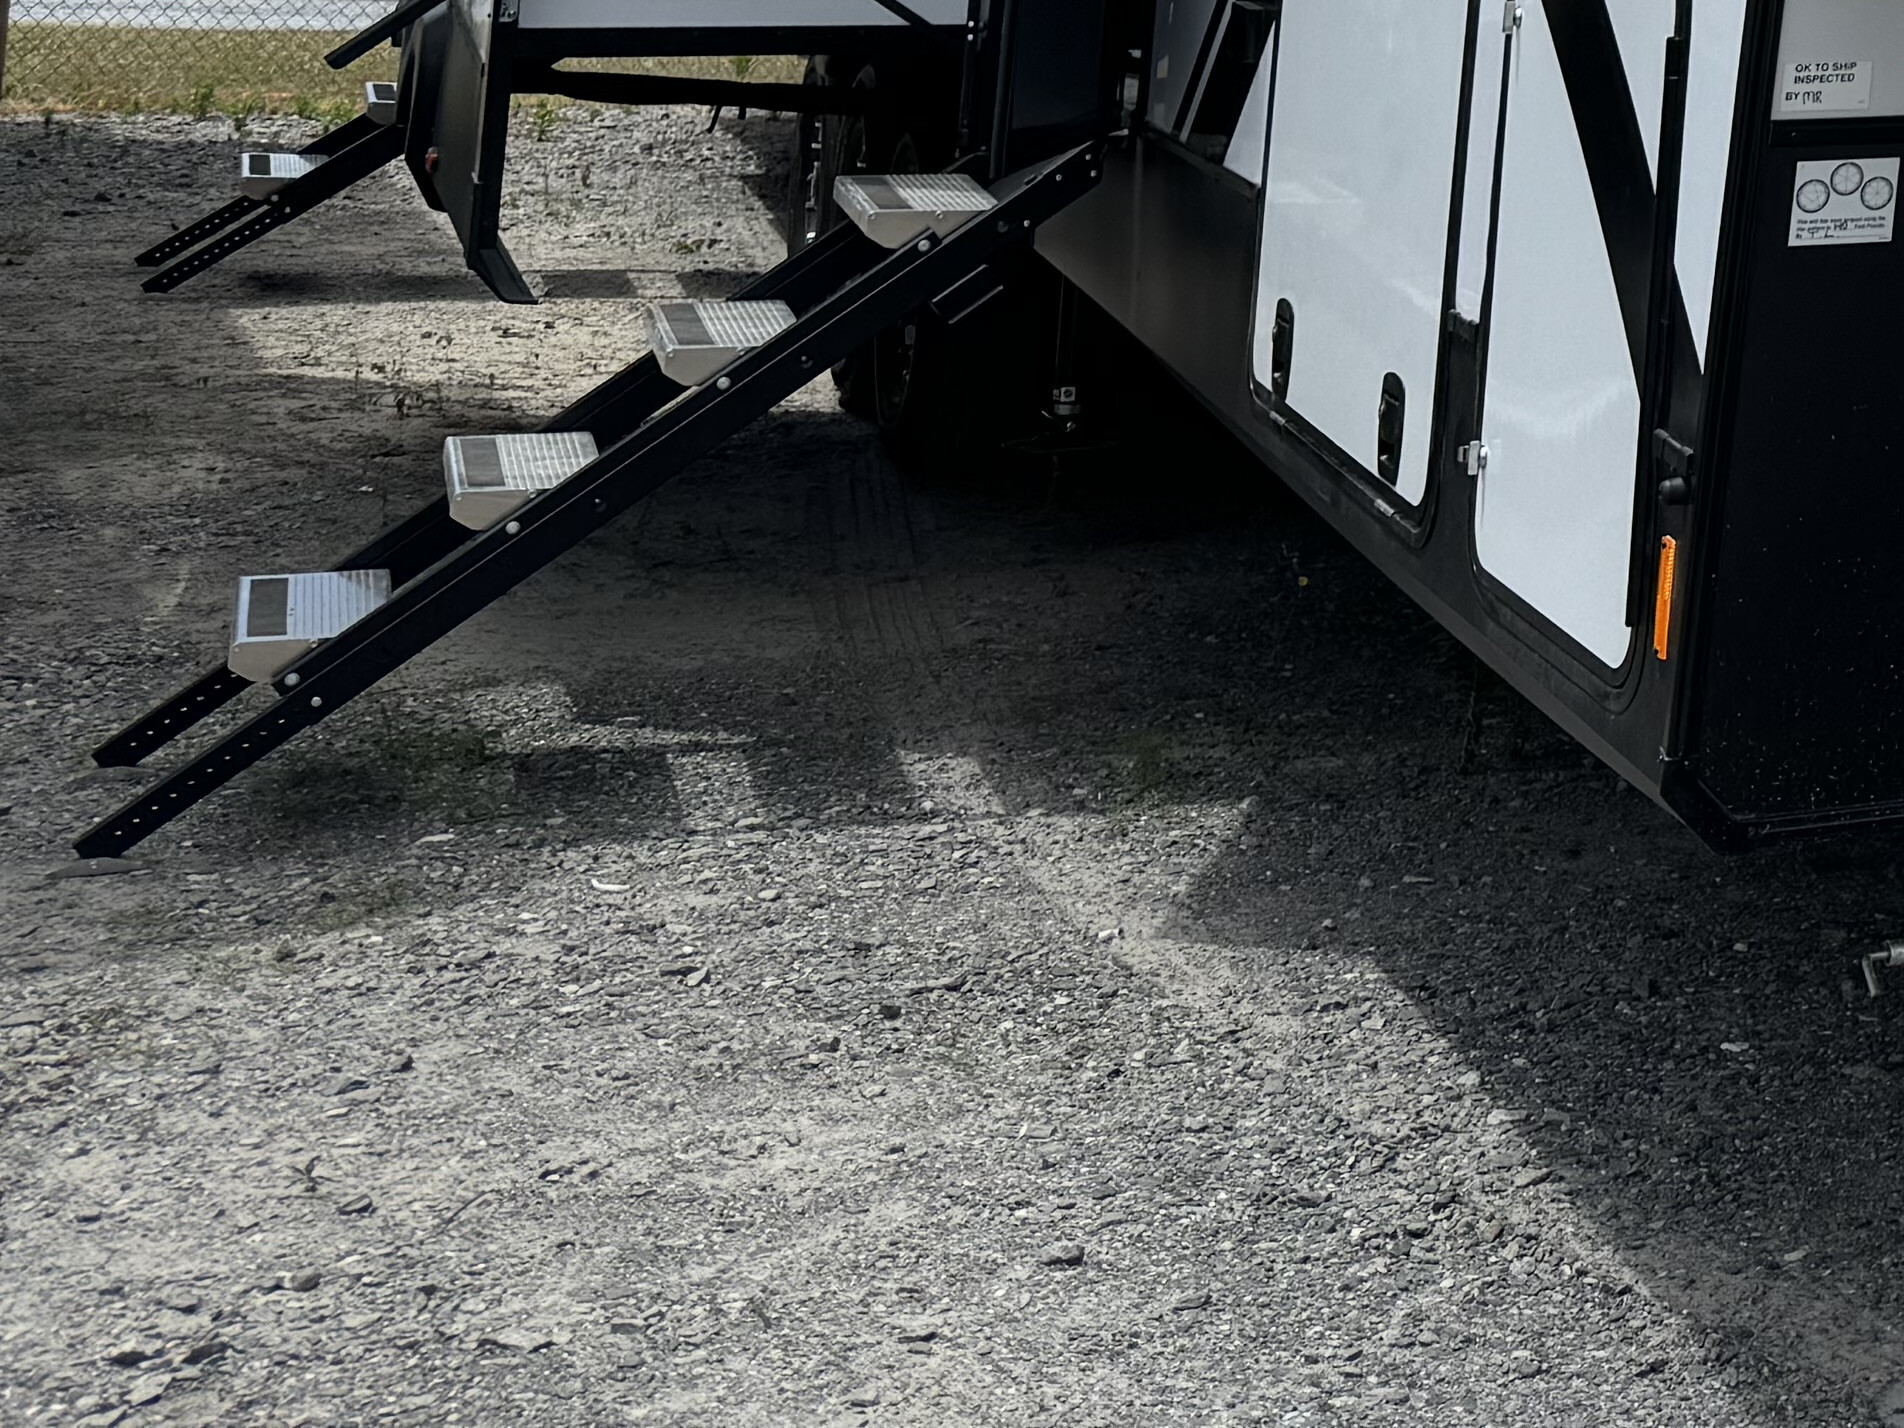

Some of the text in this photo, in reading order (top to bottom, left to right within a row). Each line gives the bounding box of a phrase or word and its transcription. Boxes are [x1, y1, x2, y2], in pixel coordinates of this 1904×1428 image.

[1795, 63, 1812, 73] OK
[1815, 63, 1830, 72] TO
[1793, 73, 1856, 85] INSPECTED
[1785, 91, 1801, 102] BY
